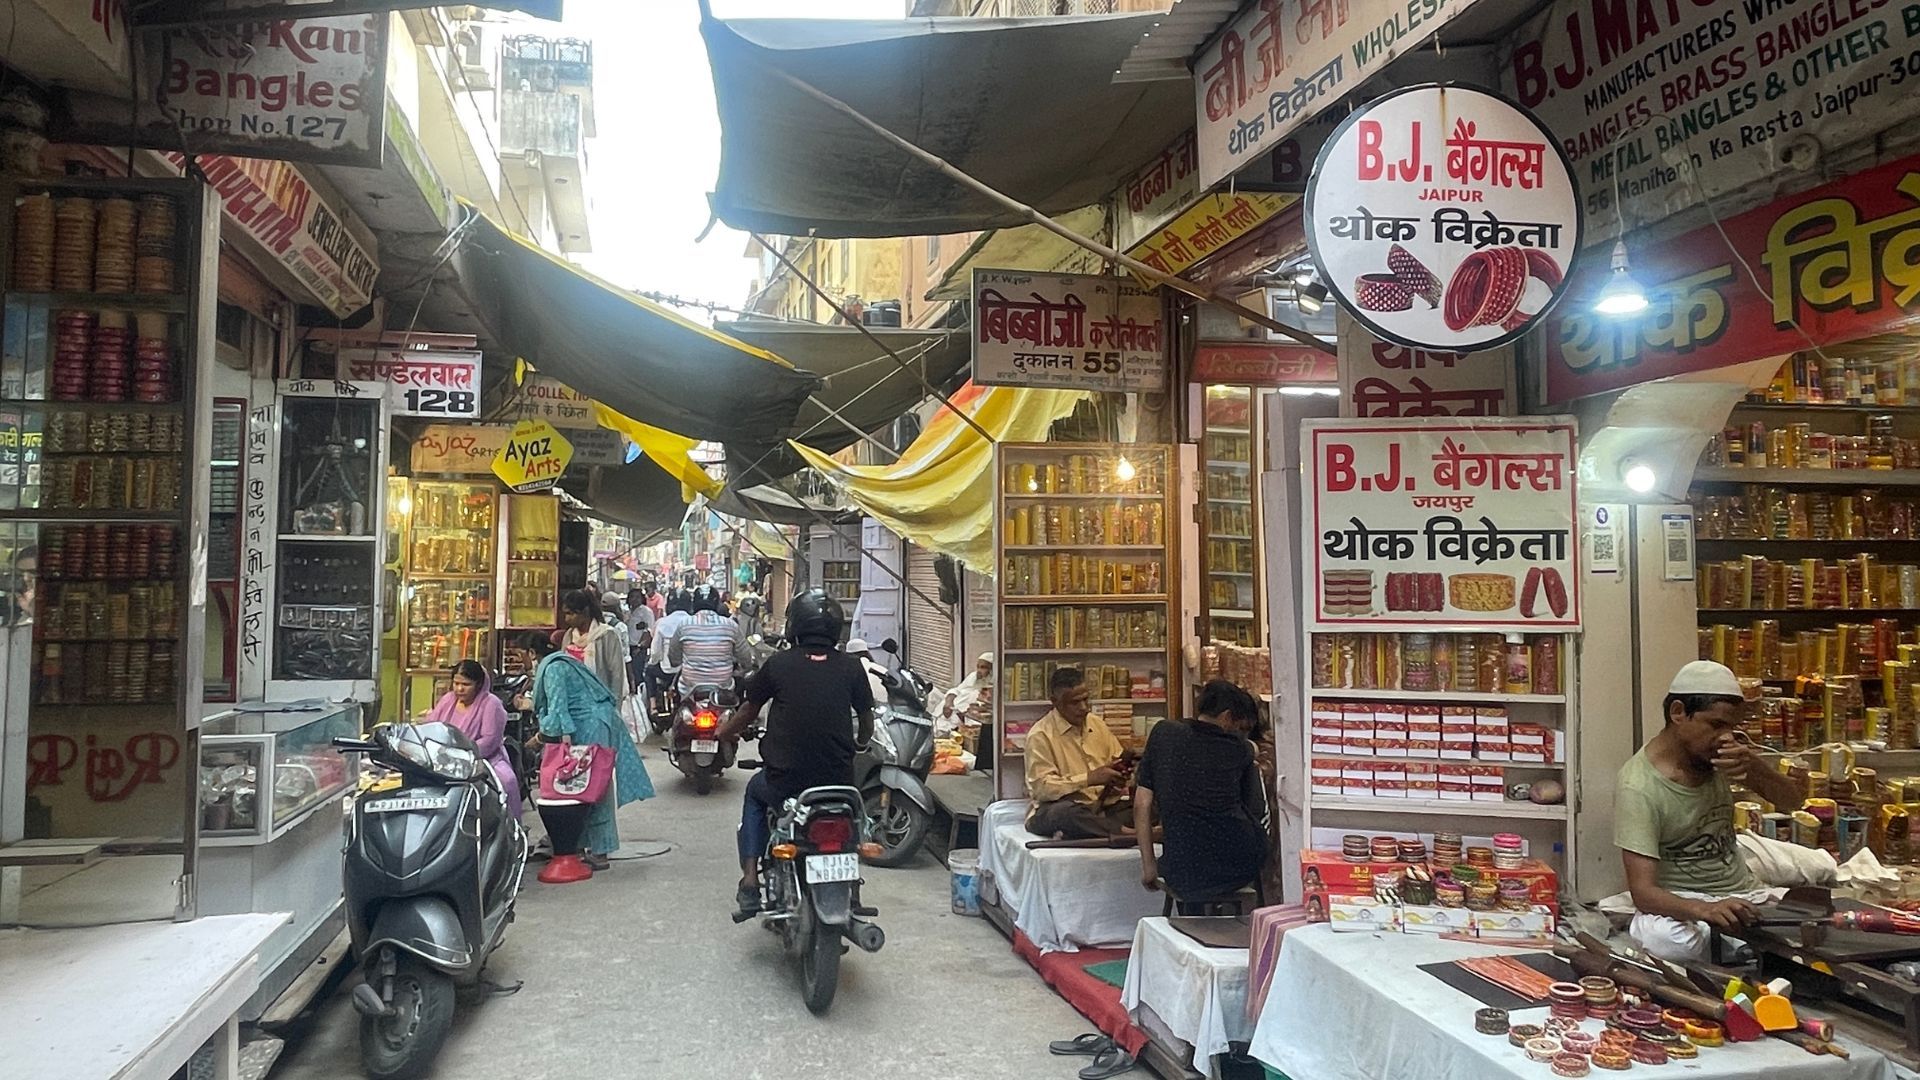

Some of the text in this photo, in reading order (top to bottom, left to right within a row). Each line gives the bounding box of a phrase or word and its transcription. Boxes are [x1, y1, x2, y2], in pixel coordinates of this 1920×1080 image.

[1584, 9, 1737, 117] MANUFACTURERS
[1228, 111, 1265, 155] थोक
[1268, 54, 1343, 130] विक्रेता
[1563, 95, 1652, 162] BANGLES
[1660, 46, 1748, 114] BRASS
[1590, 137, 1652, 184] METAL
[1655, 80, 1758, 154] BANGLES
[1765, 71, 1788, 101] &
[1792, 19, 1890, 87] OTHER
[1358, 117, 1546, 189] B.J. बैंगल्स
[1709, 136, 1734, 160] Ka
[1740, 109, 1804, 149] Rasta
[1419, 187, 1484, 203] JAIPUR
[1329, 205, 1563, 249] थोक विक्रेता
[978, 288, 1087, 349] बिब्बोजी
[1013, 352, 1060, 374] दुकान
[1082, 352, 1121, 374] 55
[404, 388, 475, 413] 128
[504, 437, 552, 467] Ayaz
[525, 457, 561, 478] Arts
[1326, 436, 1565, 492] B.J. बैंगल्स
[1411, 494, 1476, 513] जयपुर
[1323, 515, 1569, 566] थोक विक्रेता
